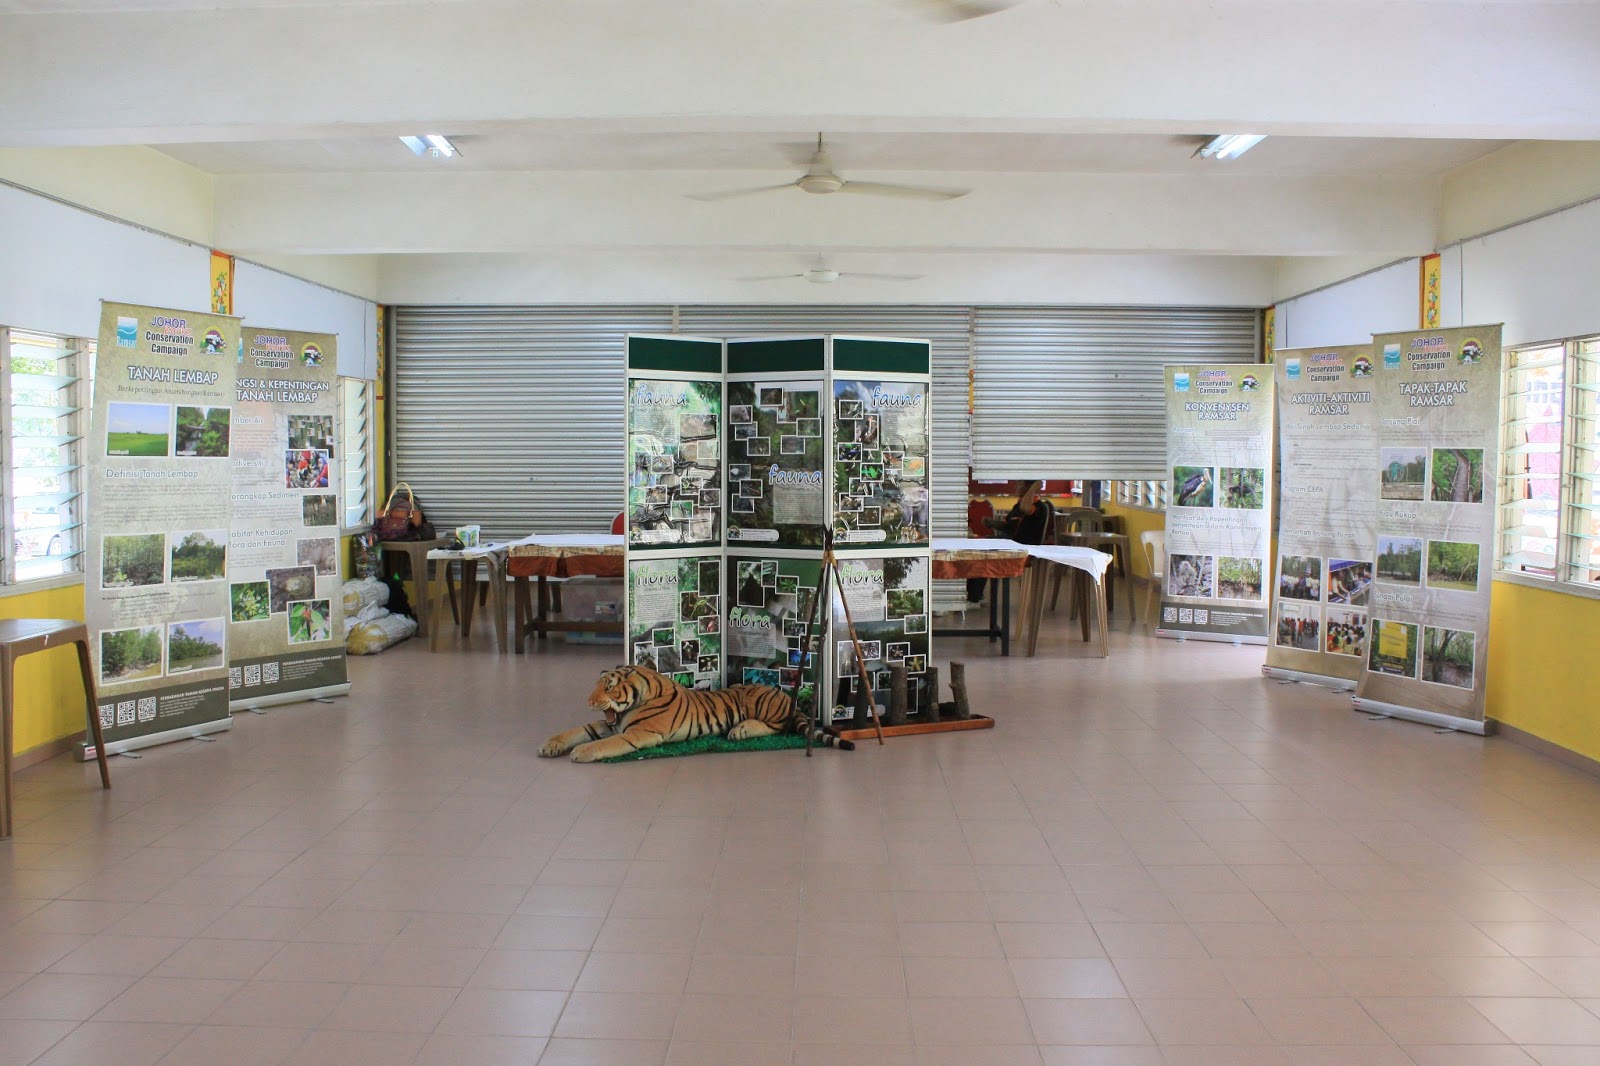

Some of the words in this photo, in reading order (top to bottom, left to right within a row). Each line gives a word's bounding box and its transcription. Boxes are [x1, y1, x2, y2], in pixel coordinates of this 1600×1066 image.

[151, 316, 186, 328] JOHOR
[145, 331, 194, 345] Conservation
[254, 335, 287, 345] JOHOR
[1411, 337, 1444, 349] JOHOR
[151, 343, 188, 356] Campaign
[250, 348, 294, 359] Conservation
[1407, 351, 1451, 361] Conservation
[255, 358, 290, 369] Campaign
[1306, 365, 1345, 374] Conservation
[1412, 362, 1445, 371] Campaign
[128, 365, 170, 382] TANAH
[174, 369, 218, 385] LEMBAP
[1310, 374, 1340, 382] Campaign
[236, 378, 257, 389] NGSI
[259, 380, 266, 389] &
[268, 380, 330, 391] KEPENTINGAN
[1399, 381, 1468, 396] TAPAK-TAPAK
[236, 389, 274, 402] TANAH
[277, 391, 318, 403] LEMBAP
[636, 383, 687, 406] fauna
[872, 385, 923, 407] fauna
[1290, 391, 1371, 405] AKTIVITI-AKTIVITI
[1410, 394, 1454, 407] RAMSAR
[1185, 402, 1250, 413] KONVENYSEN
[1309, 404, 1349, 416] RAMSAR
[234, 416, 252, 424] mber
[1198, 411, 1237, 420] RAMSAR
[232, 458, 264, 468] odiversiti
[106, 468, 140, 478] Definisi
[142, 469, 166, 478] Tanah
[768, 463, 822, 486] fauna
[232, 491, 267, 501] erangkap
[268, 491, 299, 499] Sedimen
[1394, 510, 1417, 519] Kukup
[231, 529, 254, 538] abitat
[229, 540, 245, 549] lora
[636, 565, 678, 587] flora
[840, 563, 884, 585] flora
[729, 606, 771, 630] flora
